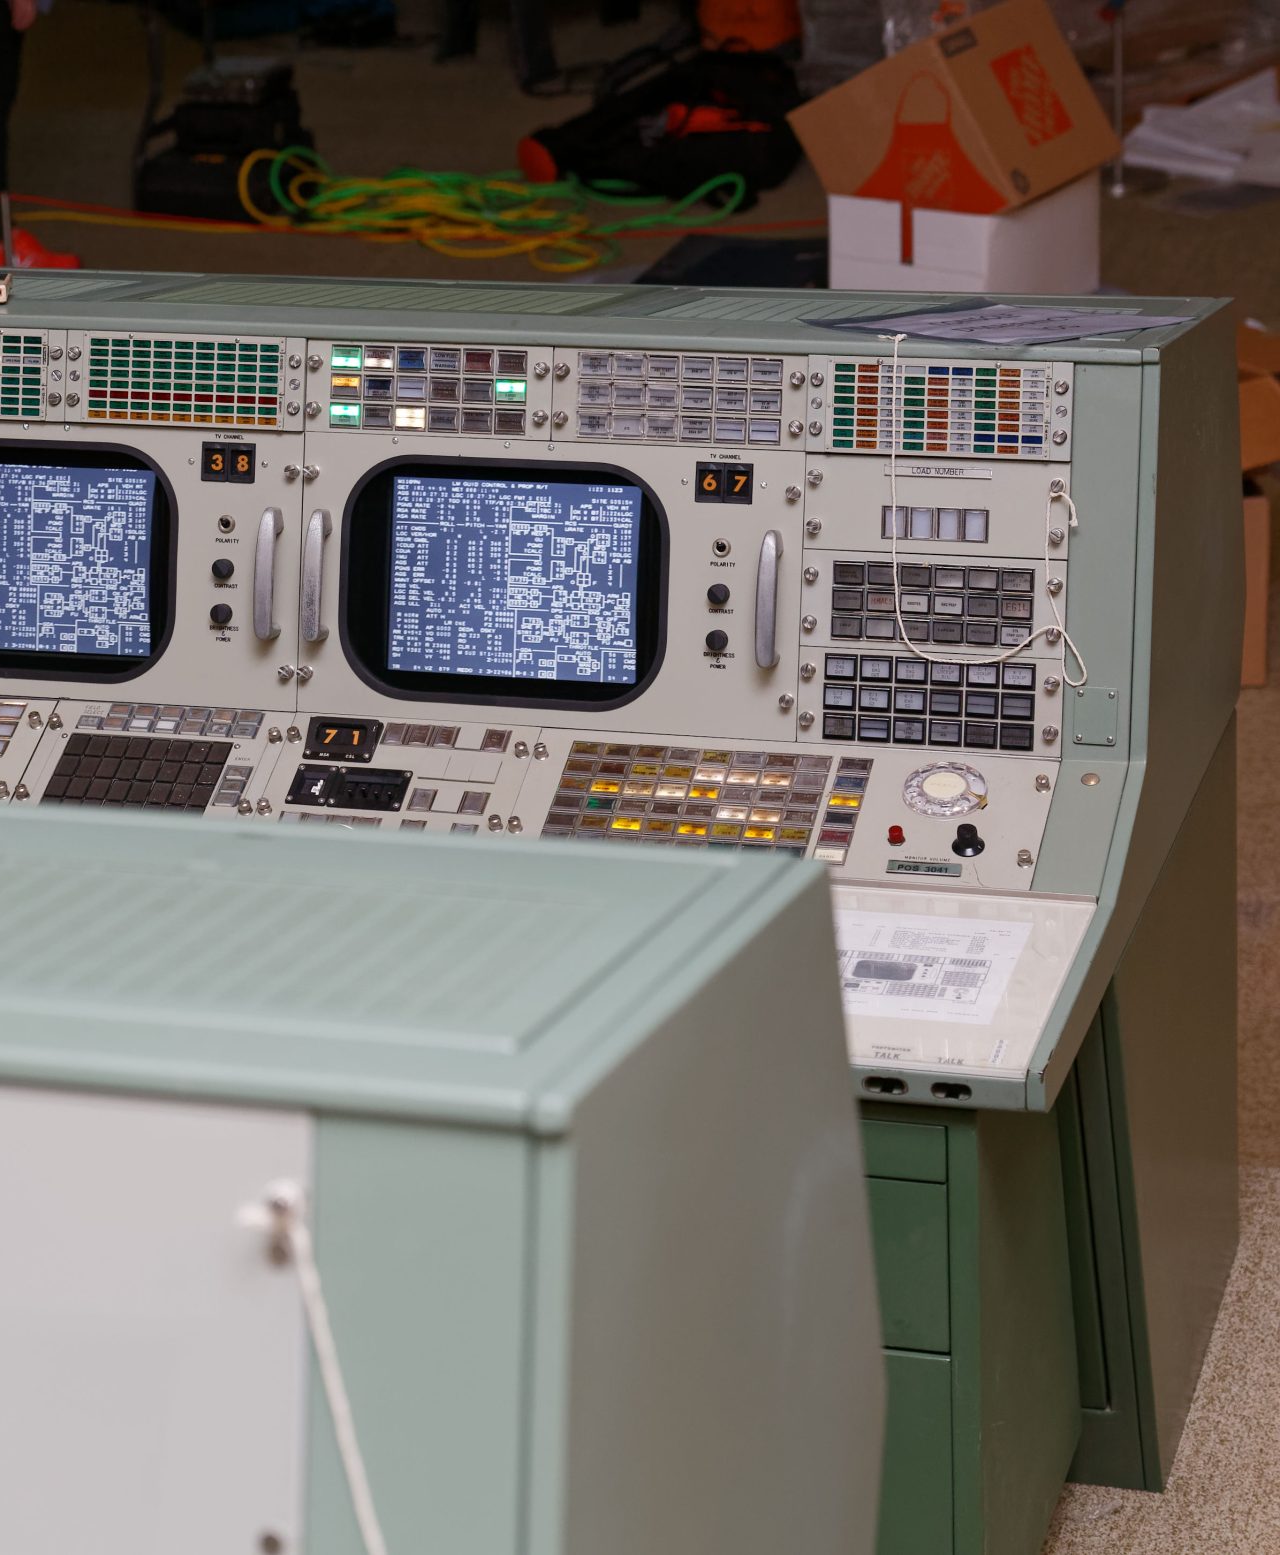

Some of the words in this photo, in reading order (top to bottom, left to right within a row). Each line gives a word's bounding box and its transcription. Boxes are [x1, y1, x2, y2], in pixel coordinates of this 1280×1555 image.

[211, 454, 223, 471] 3
[237, 455, 249, 472] 8
[703, 474, 717, 490] 6
[733, 475, 748, 492] 7
[1006, 602, 1028, 611] EGIL
[323, 729, 338, 743] 7
[352, 730, 360, 745] 1
